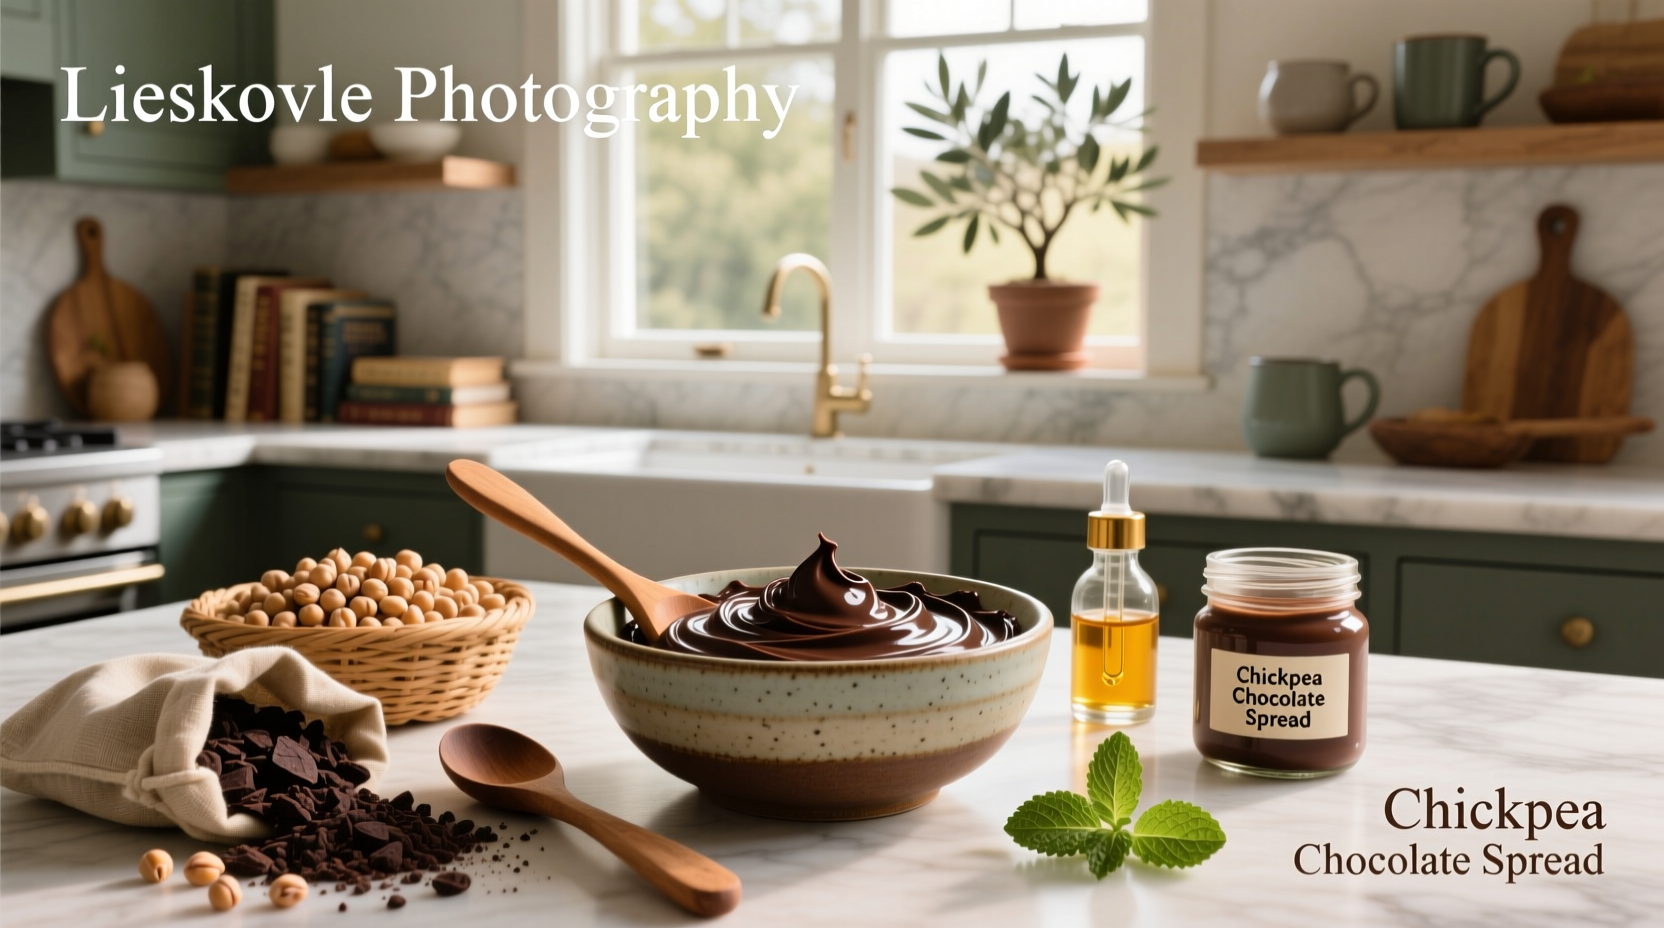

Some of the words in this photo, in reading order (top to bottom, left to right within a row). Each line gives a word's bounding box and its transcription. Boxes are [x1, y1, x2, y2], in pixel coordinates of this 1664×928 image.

[1236, 666, 1323, 690] Chickpea
[1232, 687, 1326, 707] Chocolate
[1245, 708, 1311, 731] Spread
